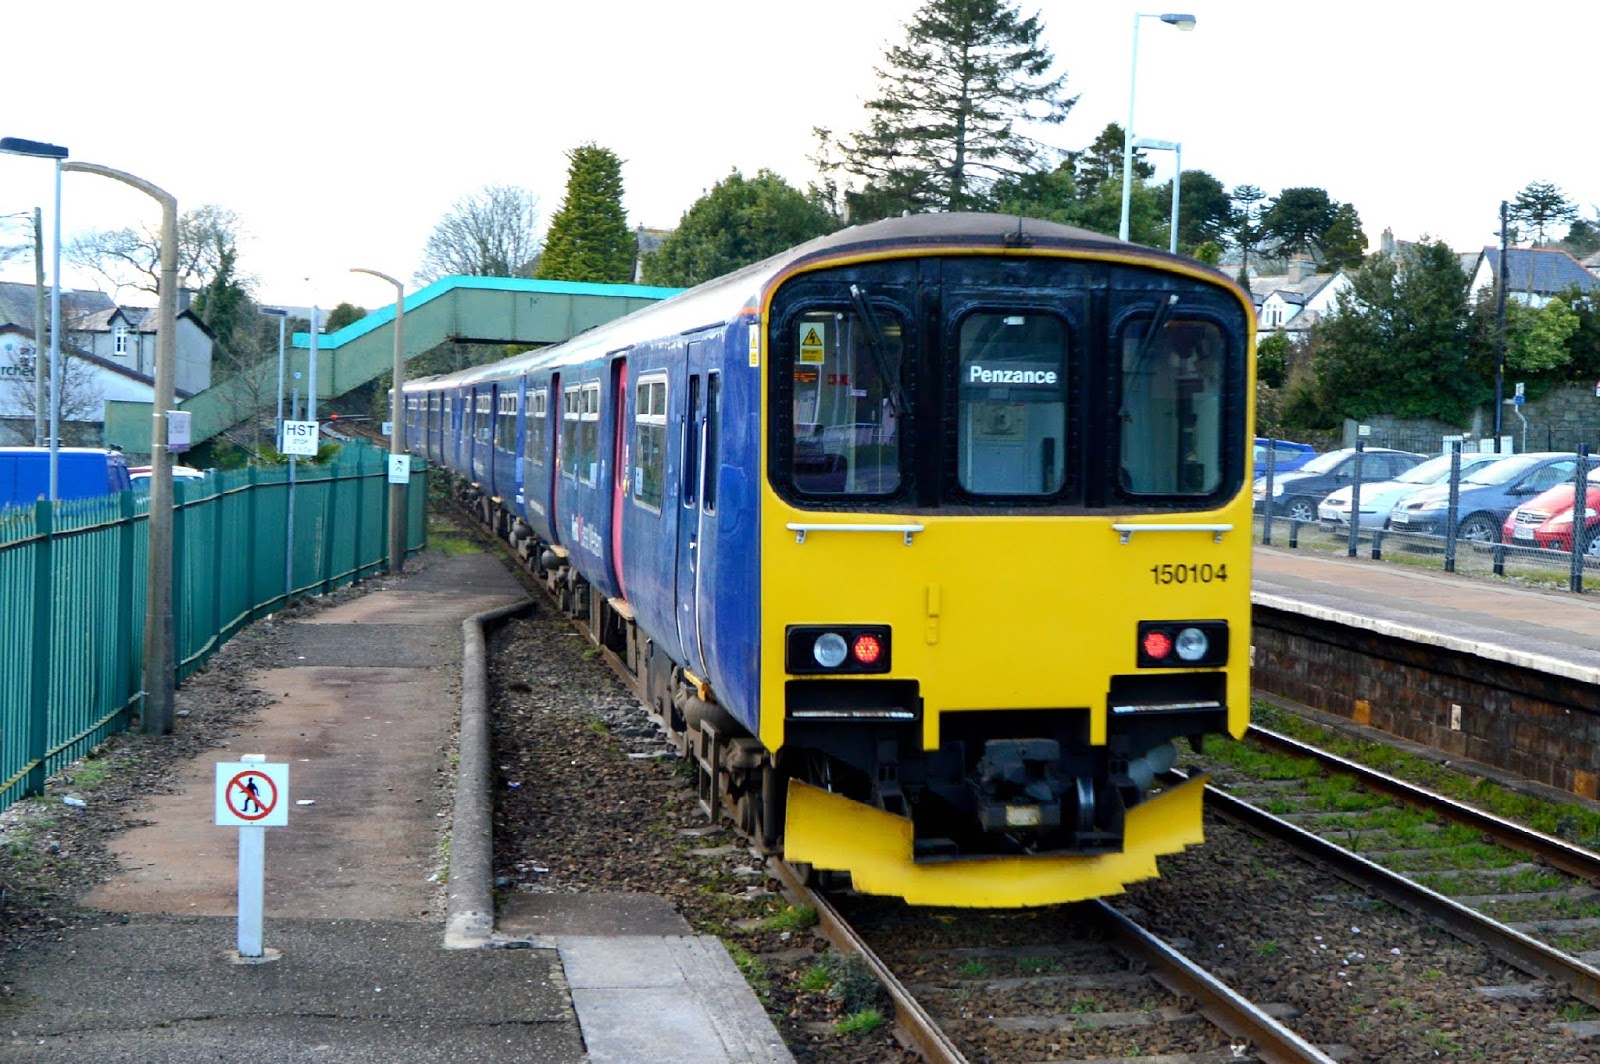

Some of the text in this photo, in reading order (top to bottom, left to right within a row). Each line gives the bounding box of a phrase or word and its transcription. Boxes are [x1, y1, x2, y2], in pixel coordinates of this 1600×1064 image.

[969, 365, 1058, 384] Penzance
[286, 424, 315, 436] HST
[1149, 563, 1228, 584] 150104
